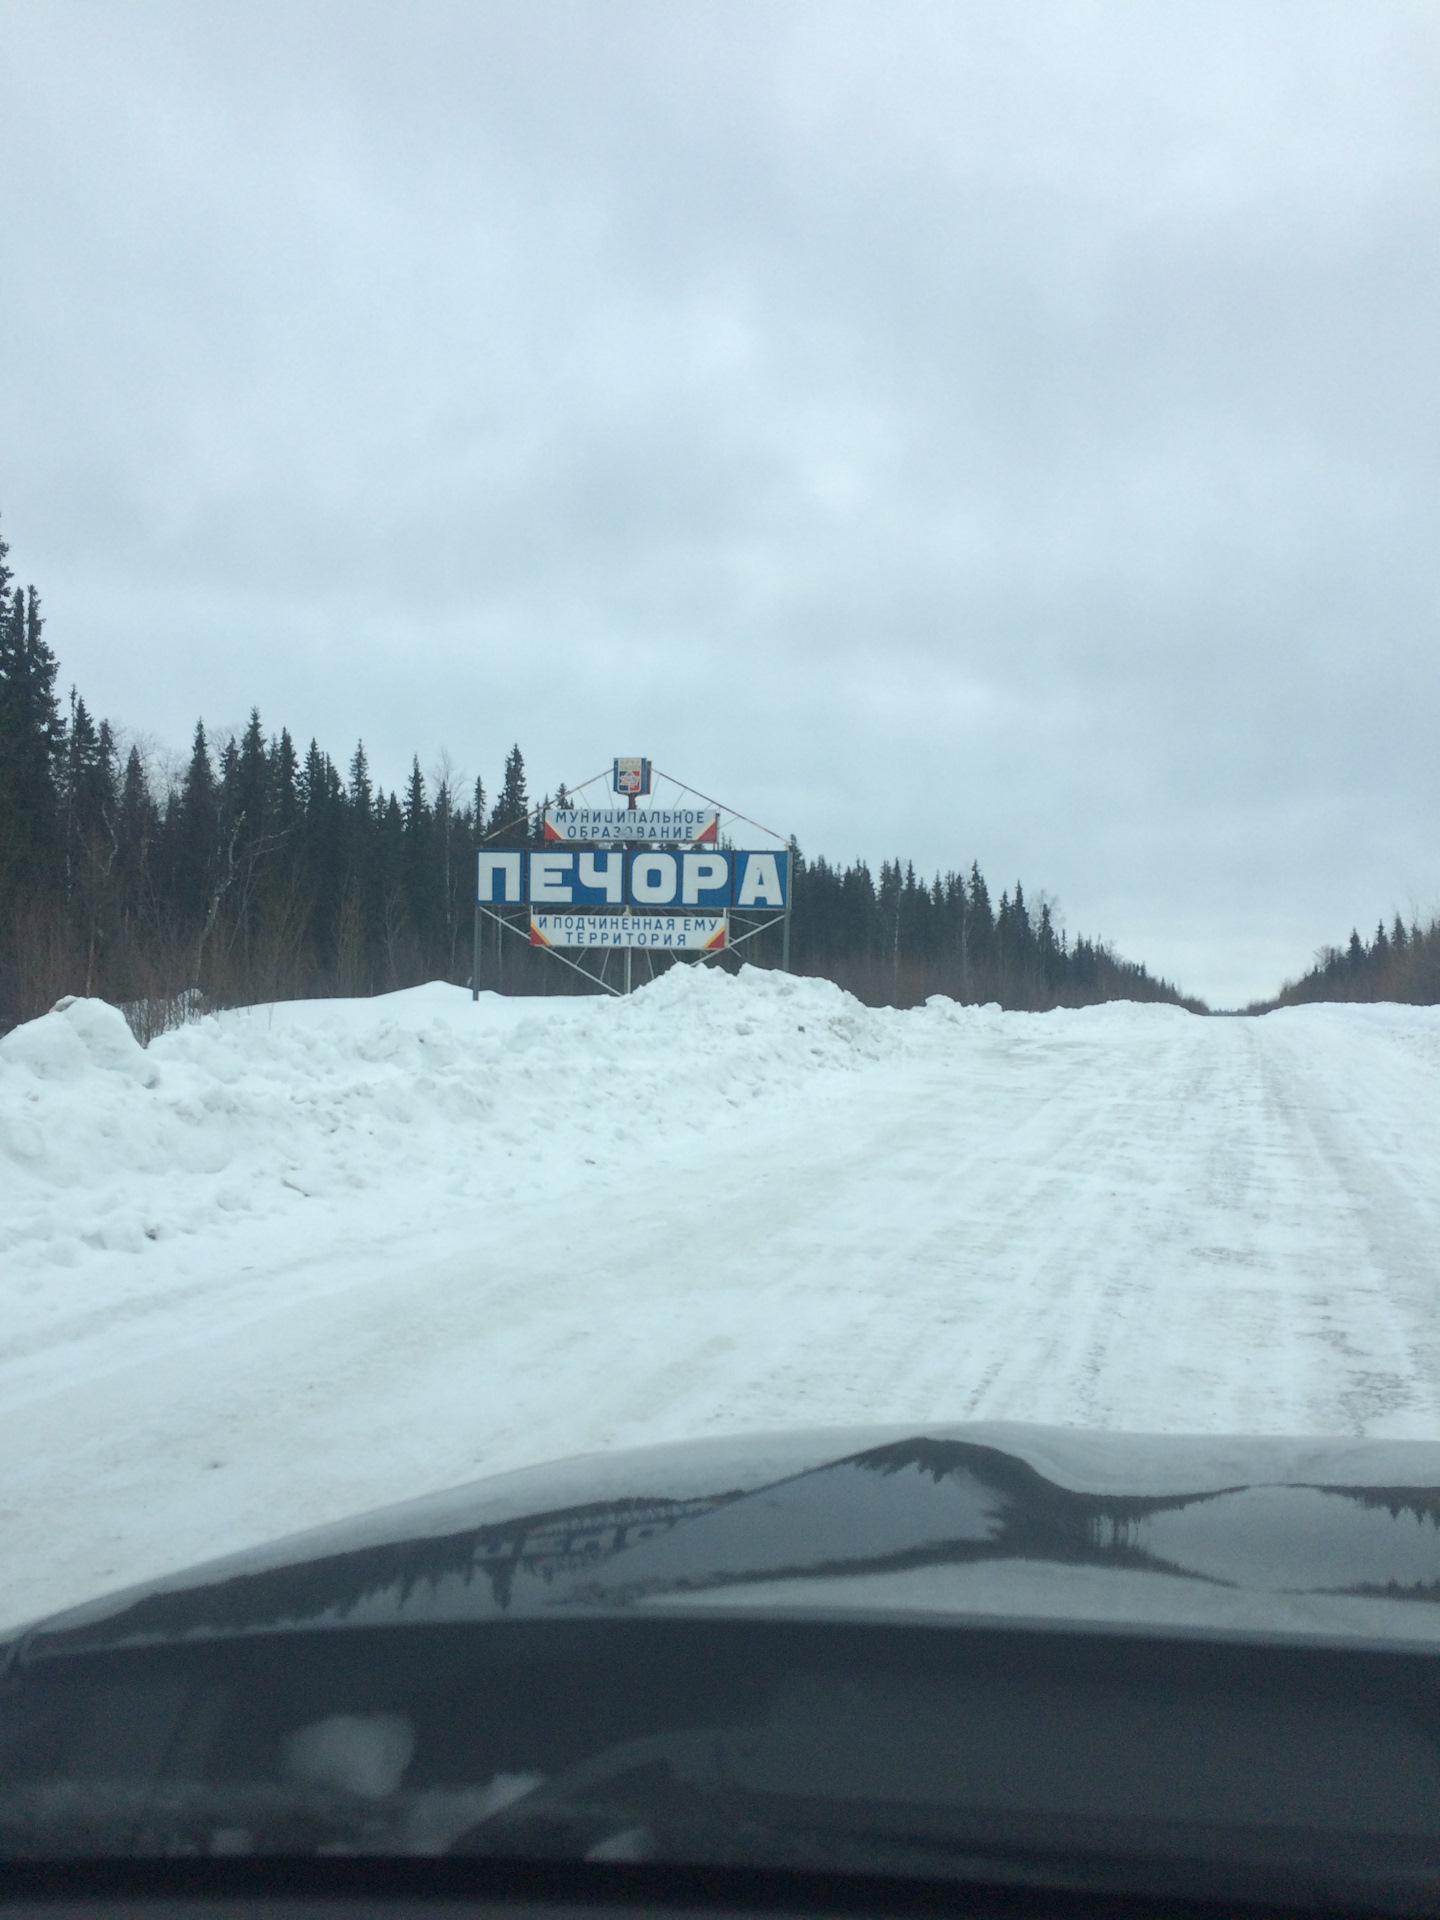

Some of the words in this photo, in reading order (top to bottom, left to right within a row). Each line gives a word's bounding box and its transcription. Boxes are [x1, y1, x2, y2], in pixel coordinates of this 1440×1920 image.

[555, 811, 705, 824] МУНИЦИПАЛЬНОЕ
[477, 852, 784, 906] ПЕЧОРА
[538, 917, 548, 929] И
[553, 916, 675, 930] ПОДЧИНЕННАЯ
[683, 918, 718, 931] ЕМУ
[566, 932, 686, 946] ТЕРРИТОРИЯ
